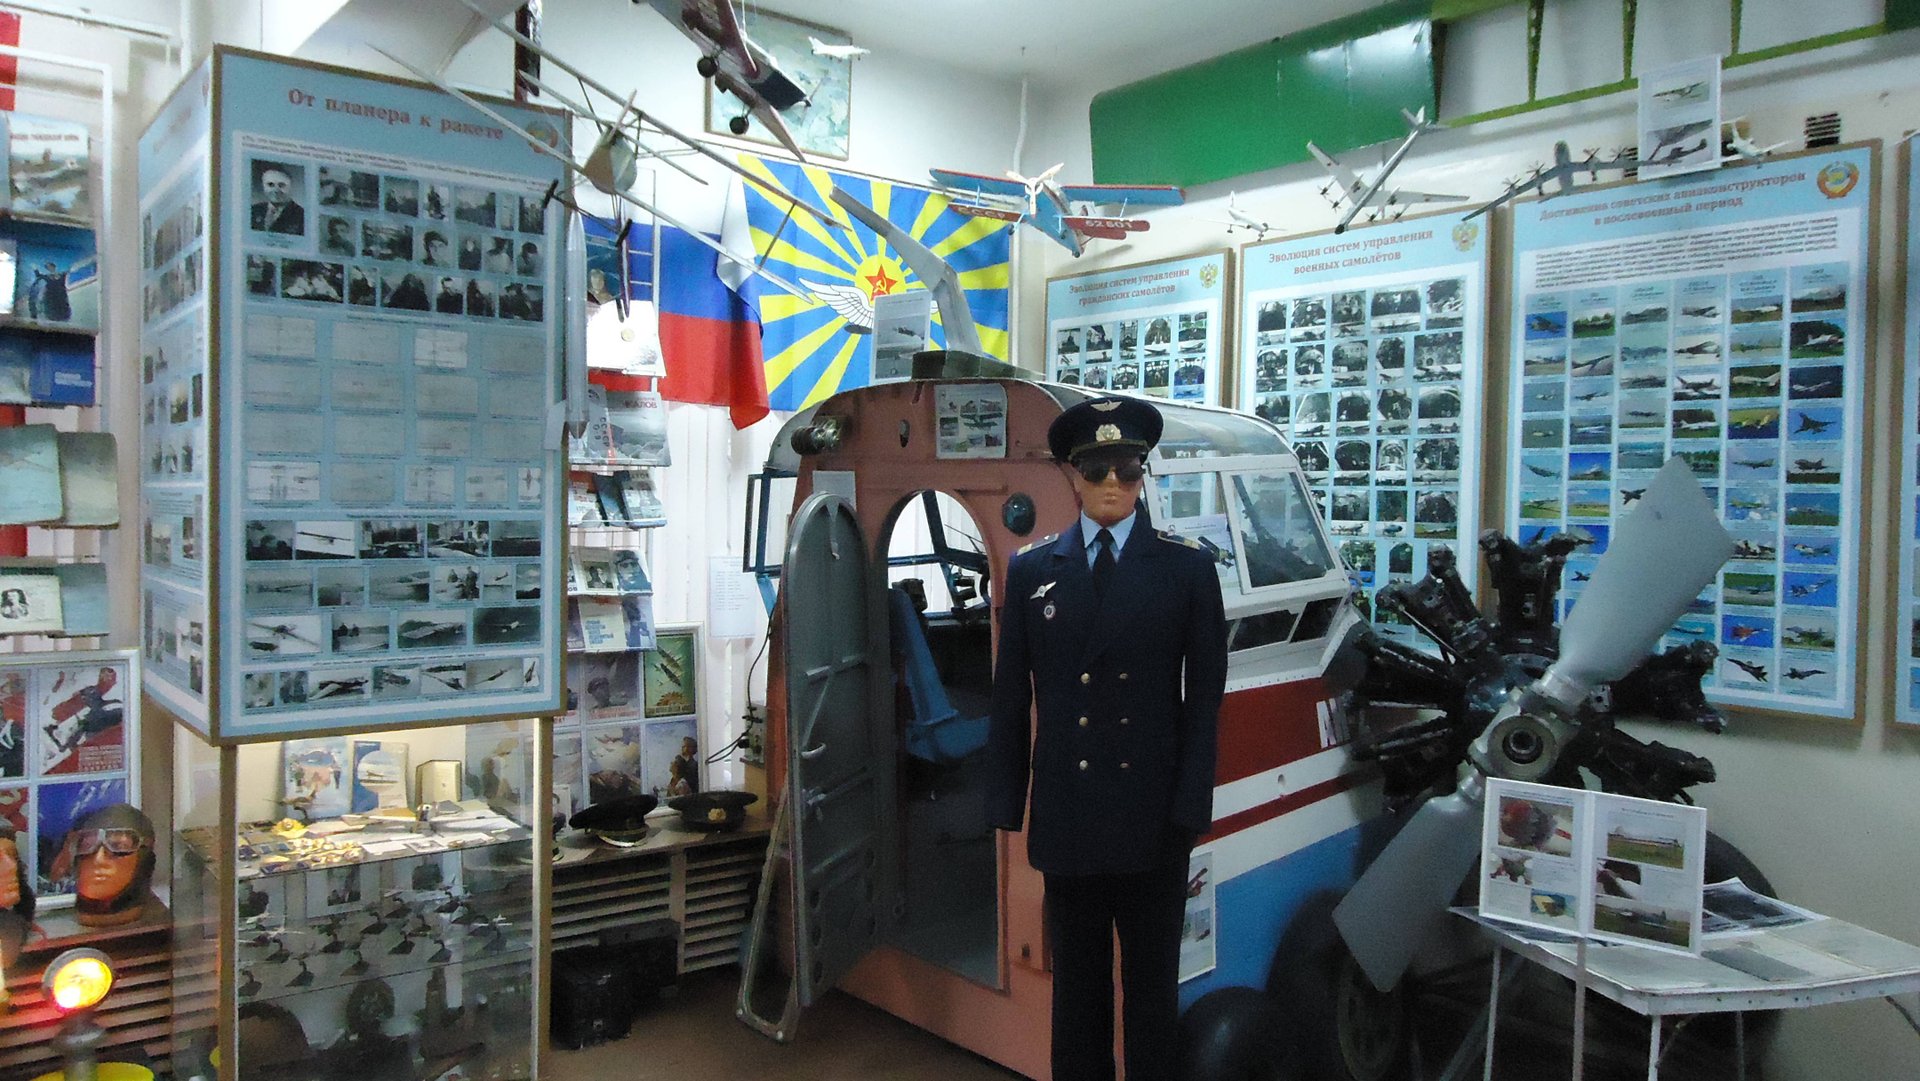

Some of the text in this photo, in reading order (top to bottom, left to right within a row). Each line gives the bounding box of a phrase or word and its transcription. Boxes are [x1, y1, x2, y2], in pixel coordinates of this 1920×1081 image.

[288, 88, 504, 139] От планера к ракете
[1604, 203, 1692, 225] послевоенный
[1695, 196, 1743, 214] период
[1269, 228, 1434, 264] Эволюция систем управления
[1294, 251, 1402, 276] военных самолётов
[1069, 269, 1189, 294] Эволюция систем управления
[1079, 284, 1176, 307] гражданских самолётов
